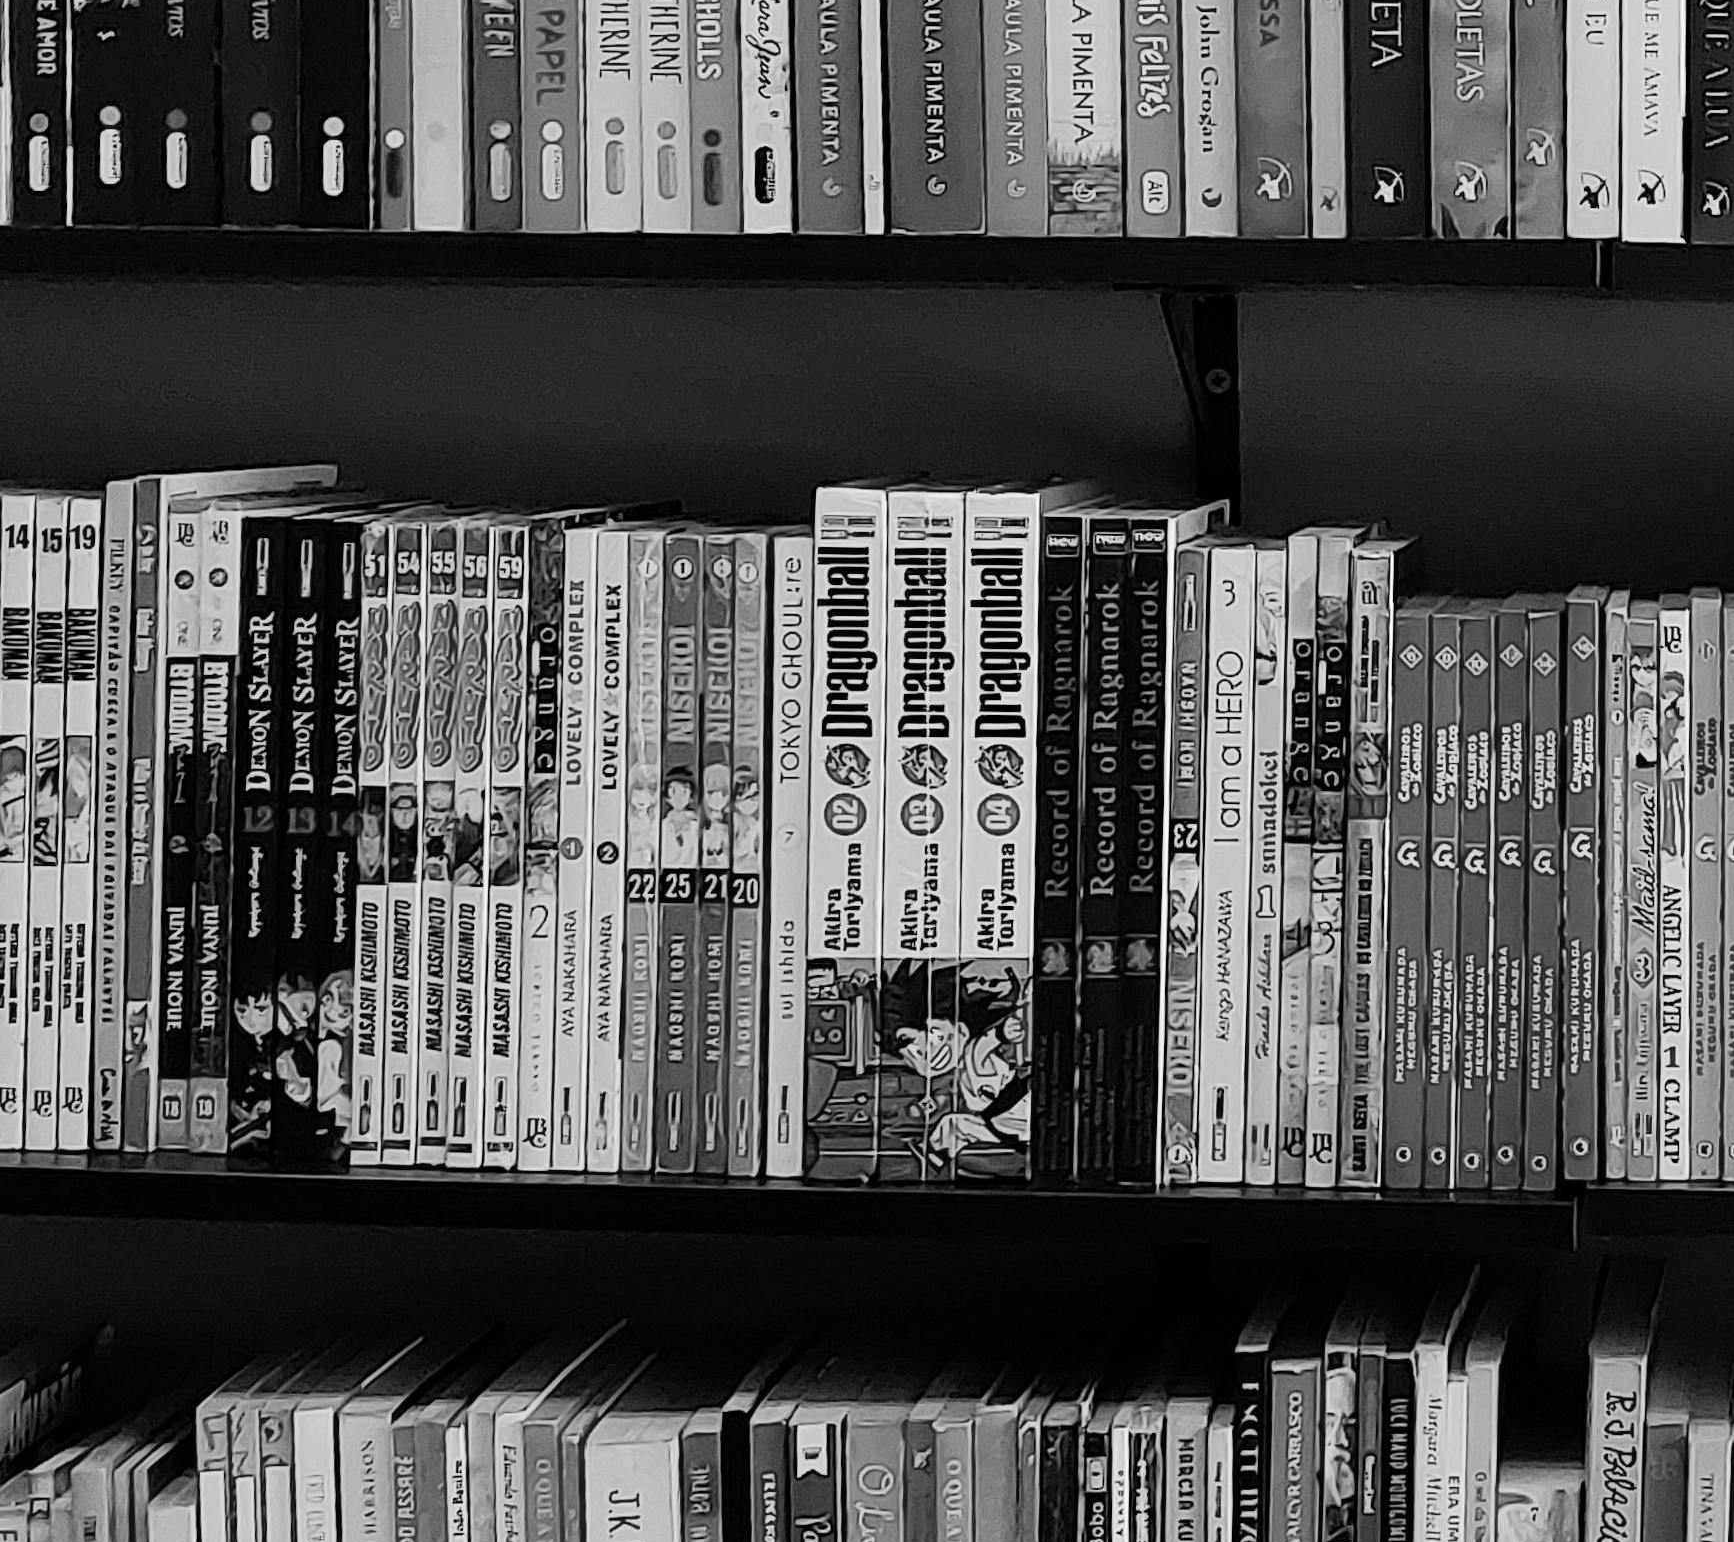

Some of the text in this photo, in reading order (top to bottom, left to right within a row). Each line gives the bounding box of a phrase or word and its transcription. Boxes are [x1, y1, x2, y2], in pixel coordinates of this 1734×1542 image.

[37, 18, 57, 74] AMOR
[1197, 7, 1220, 152] John Grogan
[817, 547, 877, 737] Dragonball
[666, 874, 690, 898] 25
[824, 889, 841, 950] Akira
[1663, 886, 1681, 967] ANGELIC
[1663, 975, 1681, 1033] LAYER
[1664, 1079, 1680, 1163] CLAMP
